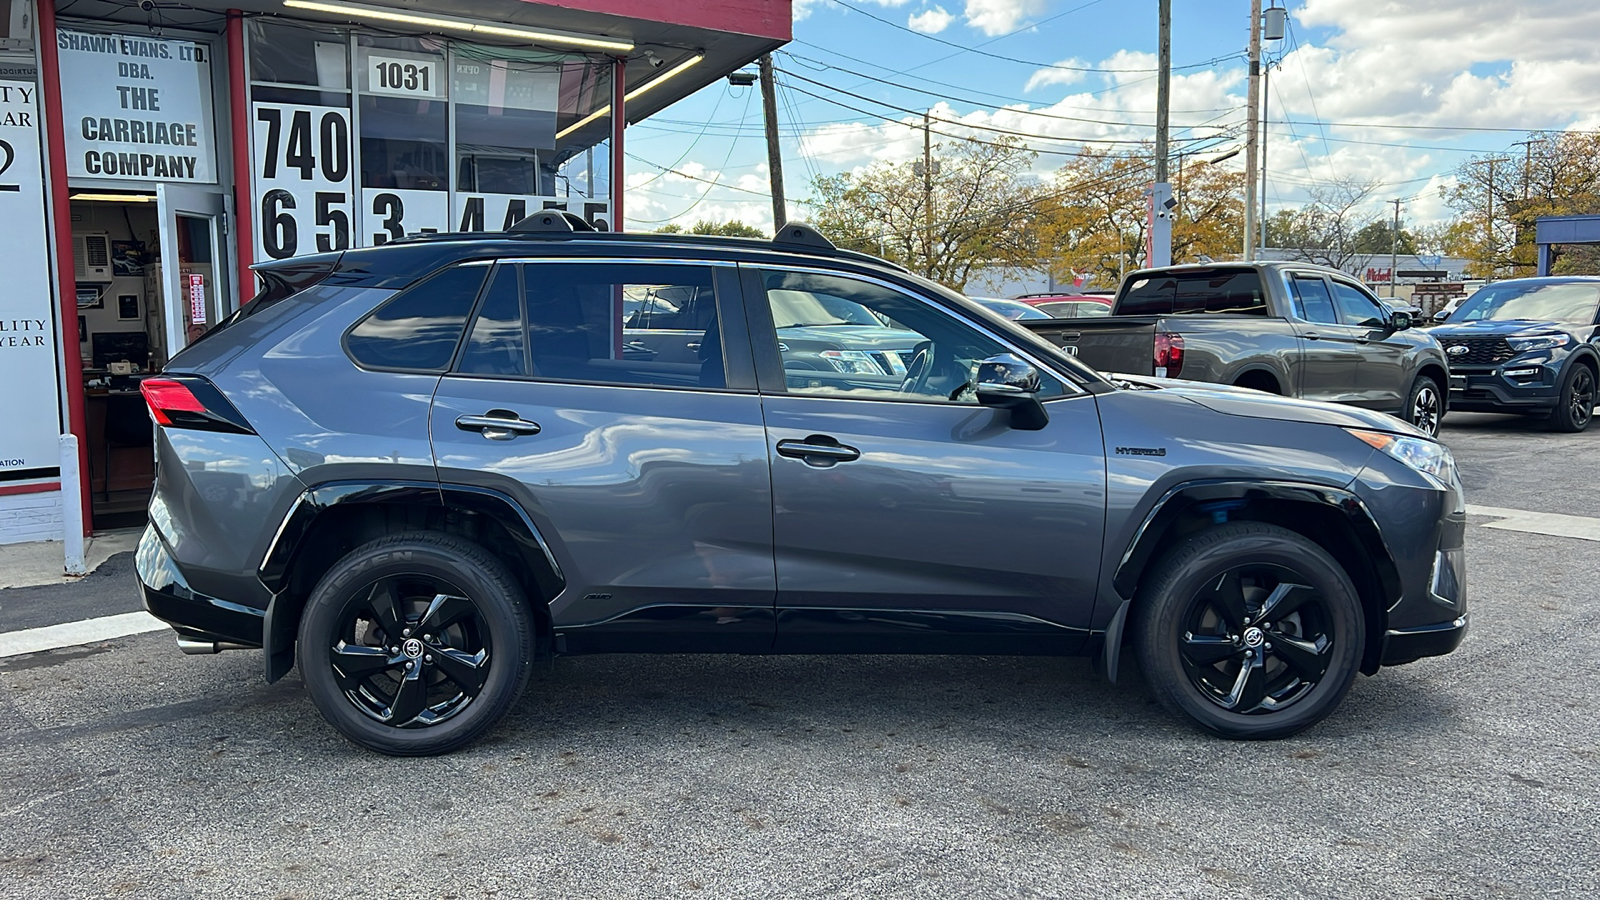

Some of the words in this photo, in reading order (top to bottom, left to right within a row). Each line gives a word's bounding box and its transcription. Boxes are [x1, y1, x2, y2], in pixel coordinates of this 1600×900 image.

[57, 32, 117, 54] SHAWN
[120, 39, 173, 60] EVANS.
[179, 45, 208, 63] LTD.
[118, 61, 154, 80] DBA.
[376, 62, 429, 92] 1031
[116, 85, 160, 112] THE
[0, 111, 33, 128] AR
[81, 116, 198, 147] CARRIAGE
[257, 107, 349, 184] 740
[85, 150, 197, 179] COMPANY
[319, 551, 412, 606] NEXEN
